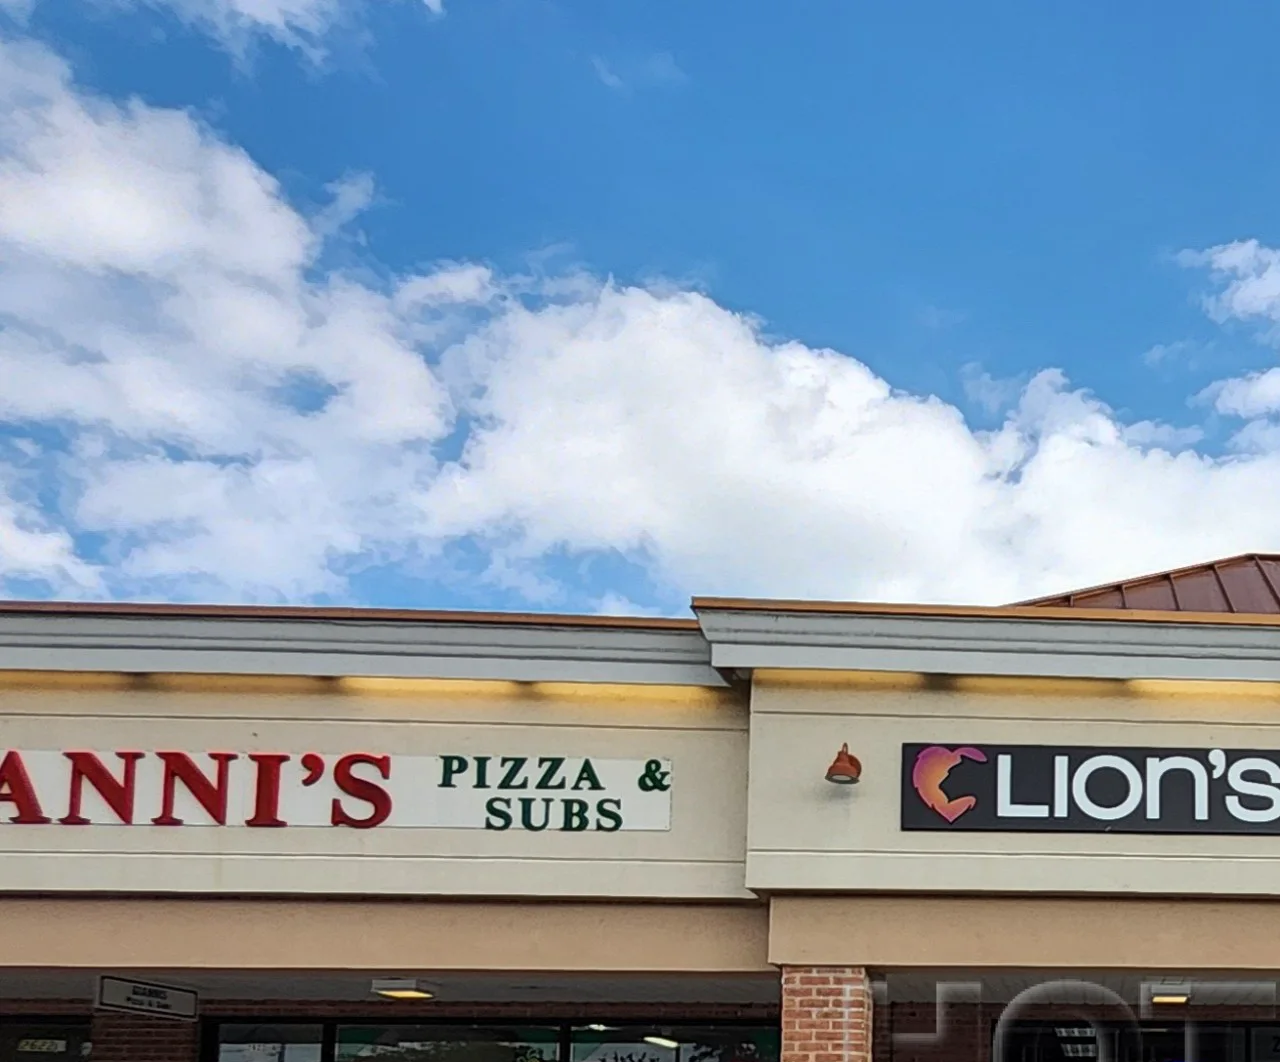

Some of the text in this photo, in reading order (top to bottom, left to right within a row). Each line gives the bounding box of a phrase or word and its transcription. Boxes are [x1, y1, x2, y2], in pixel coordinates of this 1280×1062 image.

[437, 755, 671, 792] PIZZA &
[484, 798, 624, 832] SUBS
